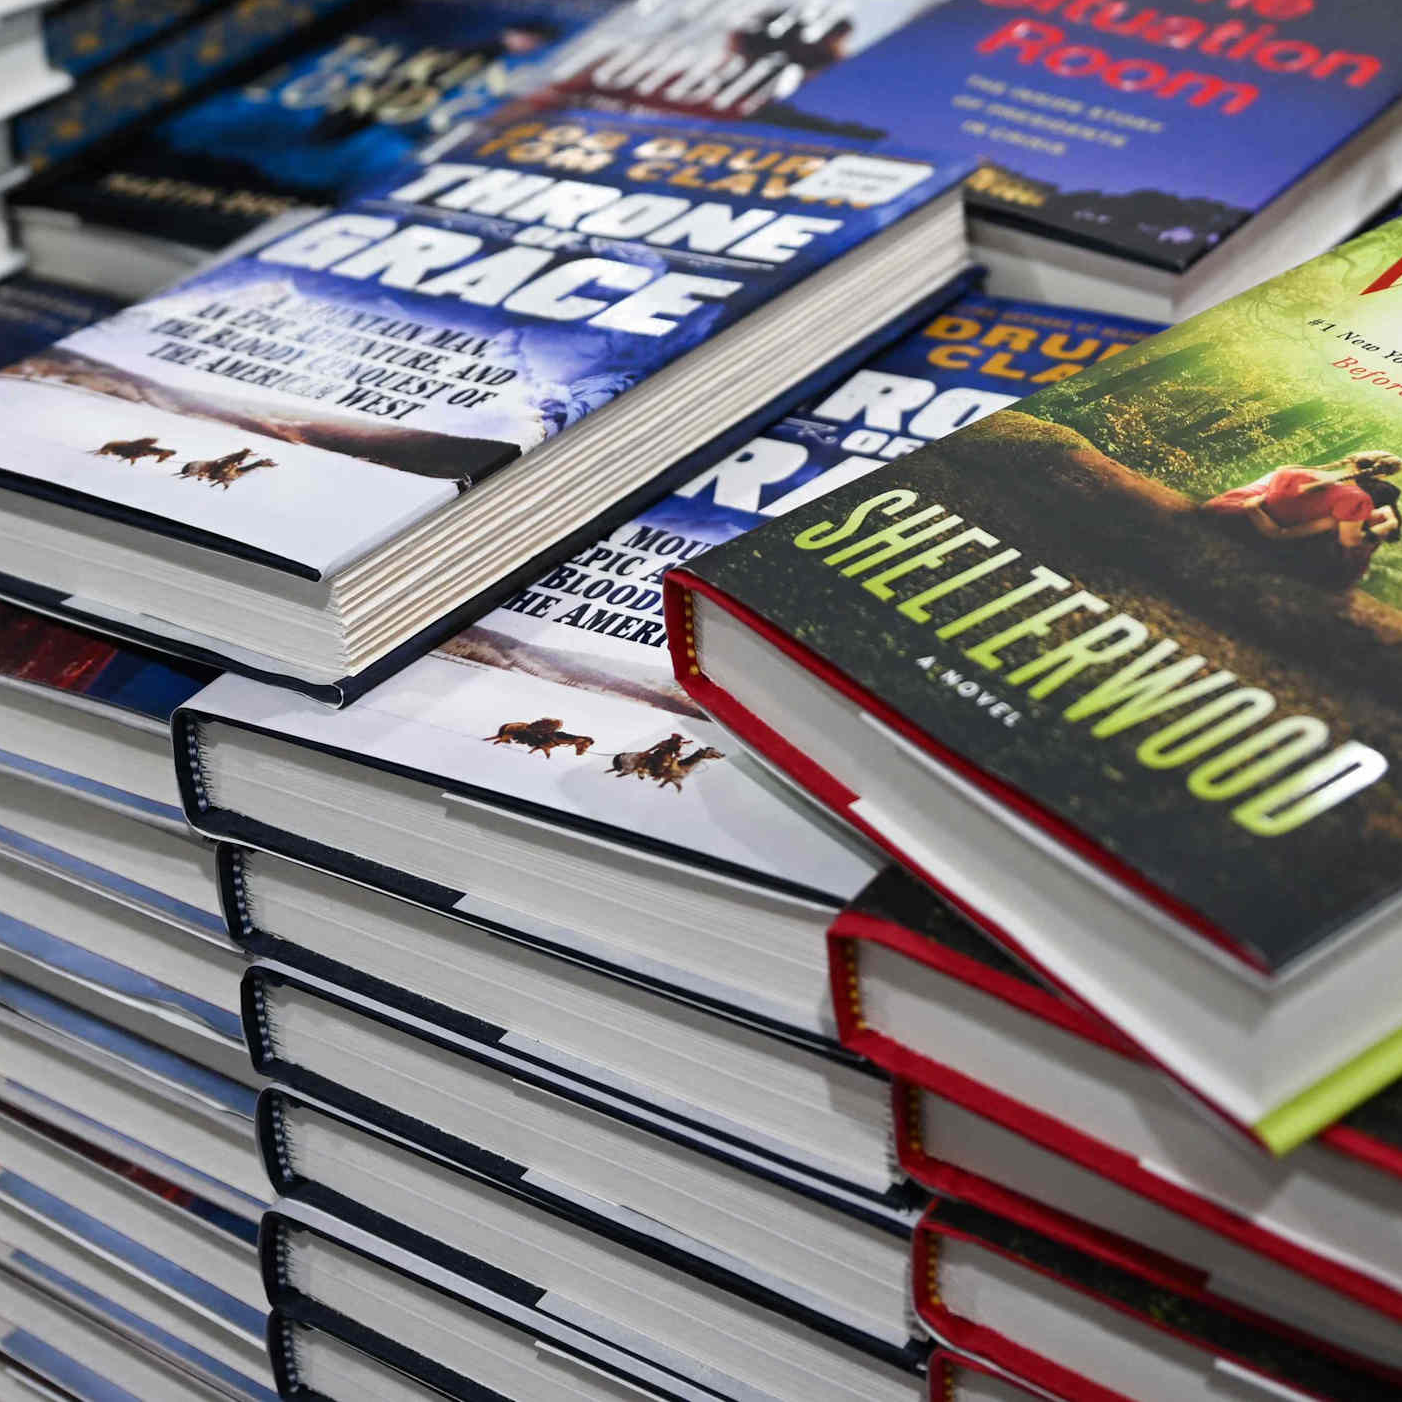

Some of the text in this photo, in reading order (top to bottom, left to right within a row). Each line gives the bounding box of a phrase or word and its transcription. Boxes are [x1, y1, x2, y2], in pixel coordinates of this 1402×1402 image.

[977, 19, 1260, 115] Room
[633, 136, 828, 180] DRUR
[388, 162, 845, 264] THRONE
[512, 225, 585, 251] OF
[259, 213, 745, 338] GRACE
[426, 328, 500, 360] MAN,
[923, 314, 1133, 362] DRU
[1307, 317, 1338, 334] #1
[1336, 330, 1382, 353] New
[147, 340, 206, 367] THE
[334, 384, 427, 421] WEST
[198, 327, 305, 367] BLOODY
[446, 386, 500, 410] OF
[448, 363, 519, 387] AND
[926, 344, 1086, 384] CLA
[620, 524, 716, 562] MOU
[538, 565, 664, 618] BLOOD
[501, 588, 669, 649] HE AMERI
[792, 485, 1391, 839] SHELTERWOOD
[915, 655, 1022, 728] A NOVEL
